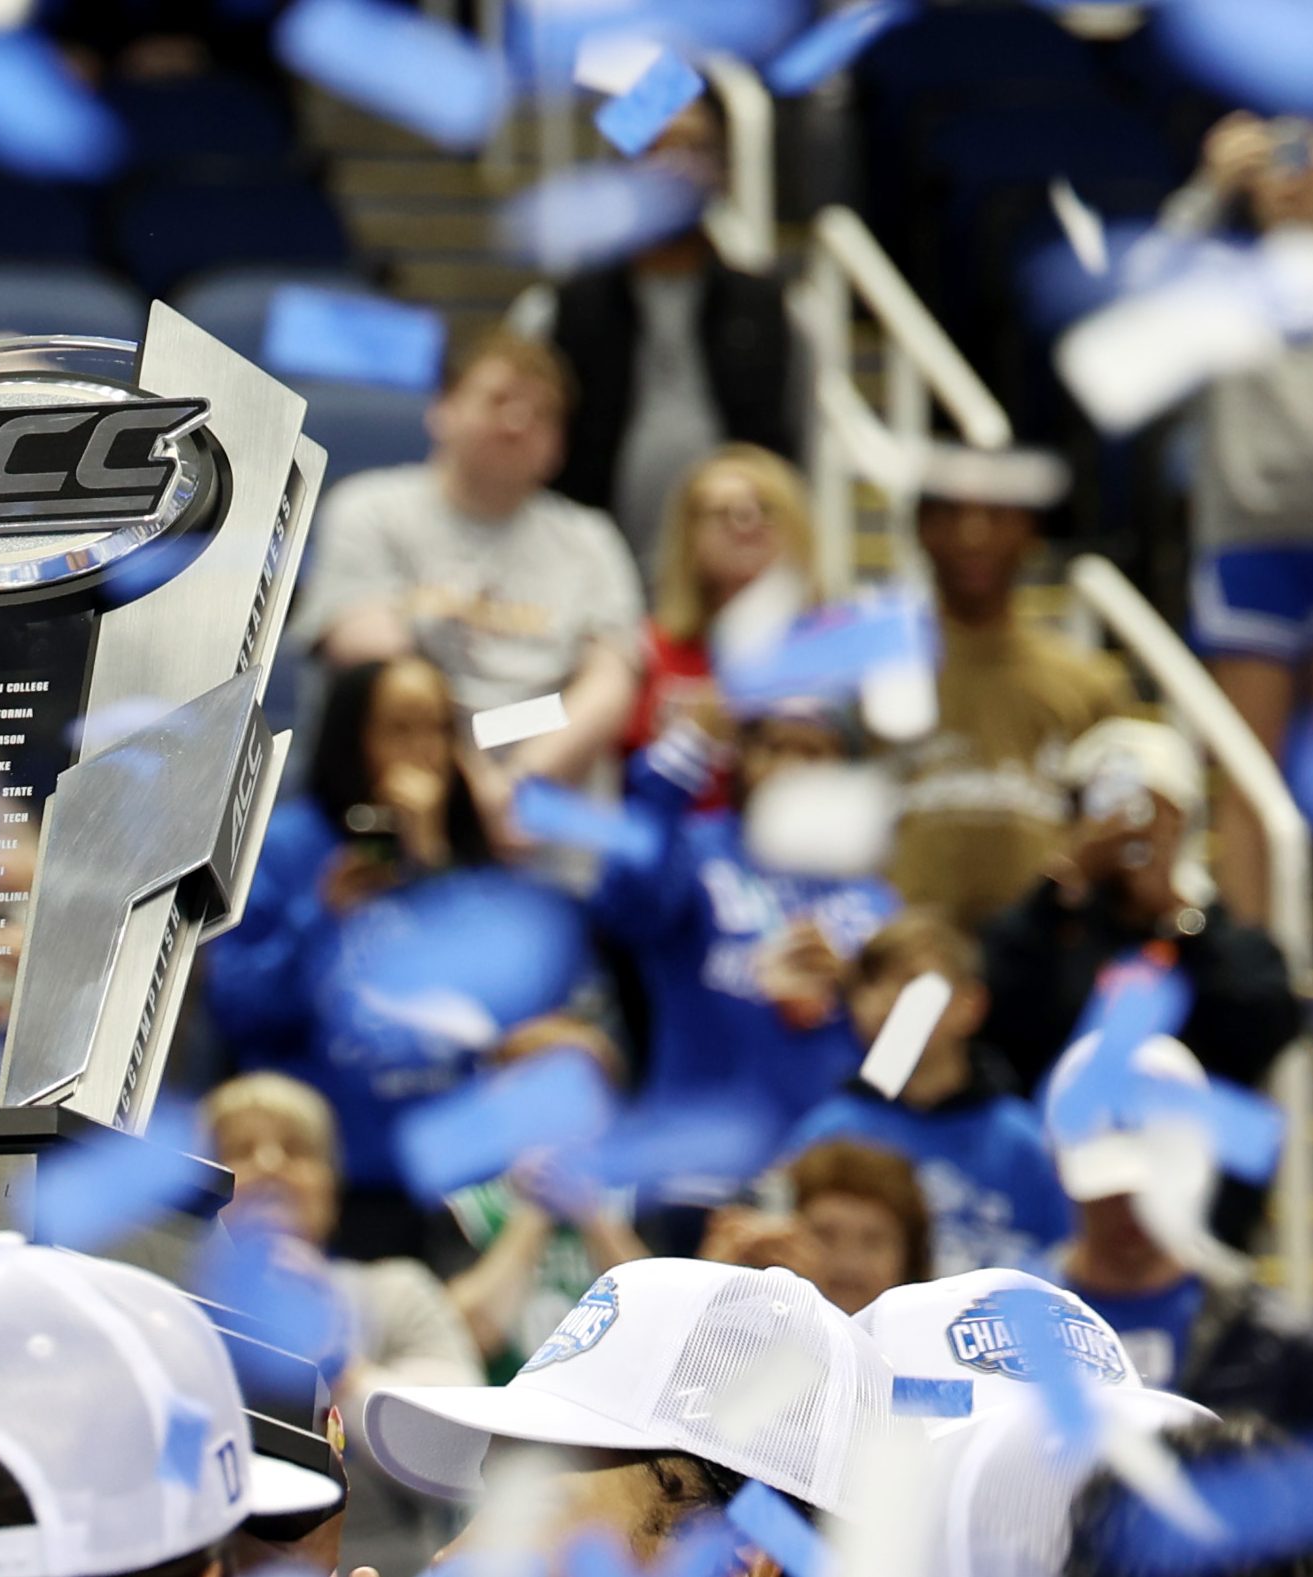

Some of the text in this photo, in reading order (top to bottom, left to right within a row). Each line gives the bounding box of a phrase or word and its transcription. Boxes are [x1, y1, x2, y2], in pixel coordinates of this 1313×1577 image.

[238, 493, 292, 674] REATNESS
[6, 681, 50, 693] COLLEGE
[2, 786, 34, 797] STATE
[230, 721, 263, 864] ACC
[3, 812, 29, 823] TECH
[951, 1319, 1123, 1371] CHAIONS
